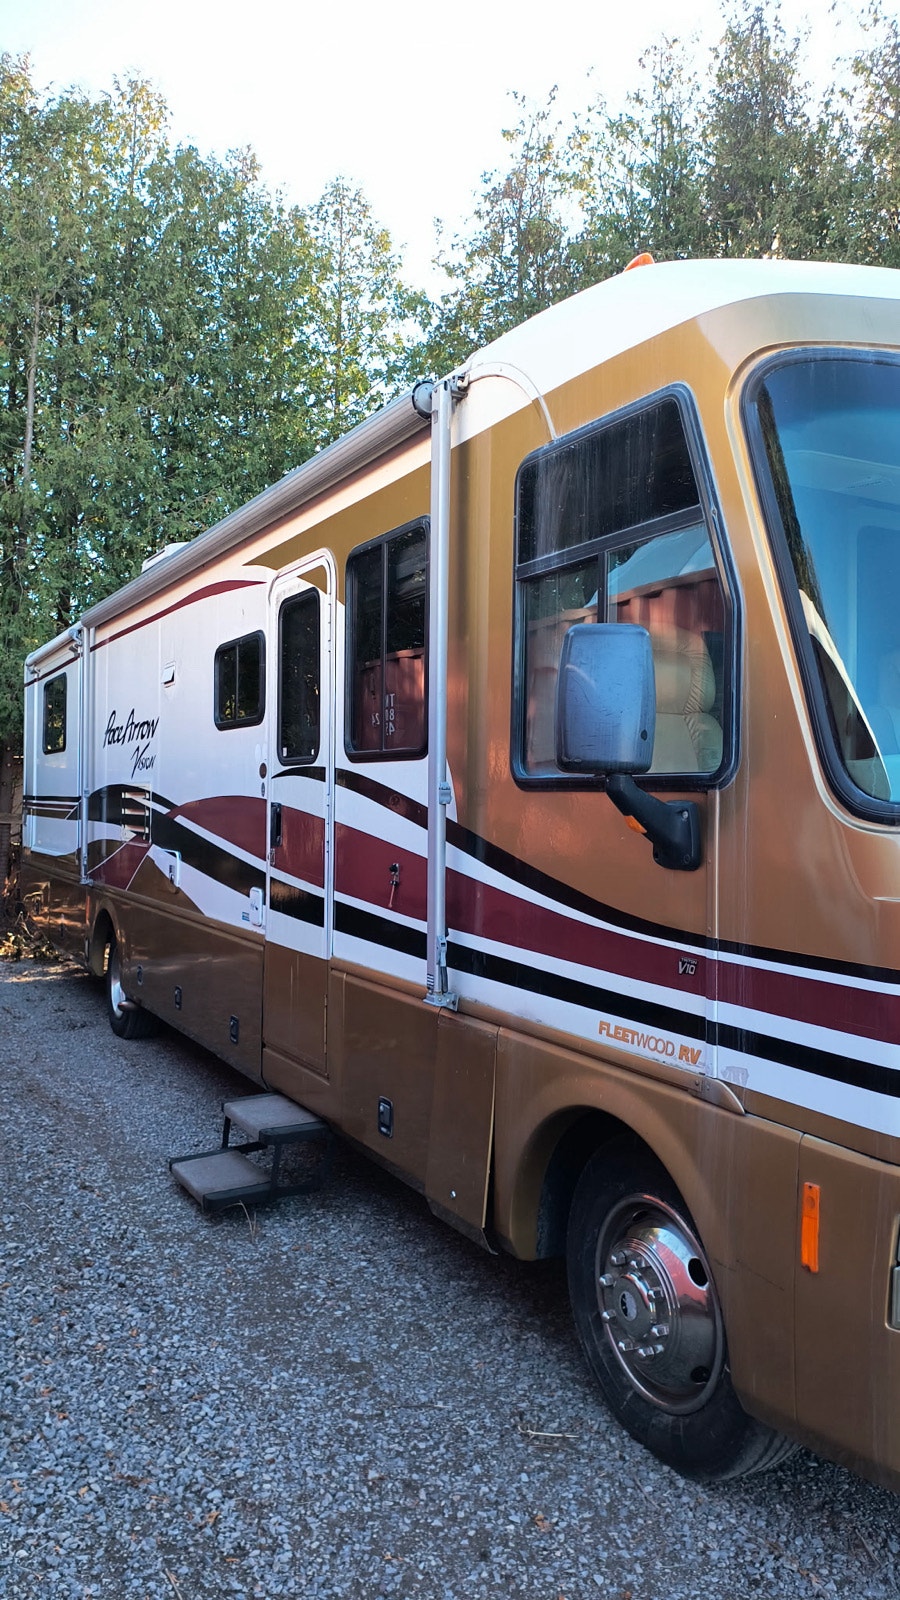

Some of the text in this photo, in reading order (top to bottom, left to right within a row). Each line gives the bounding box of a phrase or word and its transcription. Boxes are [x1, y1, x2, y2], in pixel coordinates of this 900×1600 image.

[678, 961, 695, 975] V10
[598, 1020, 702, 1065] FLEETWOOD RV
